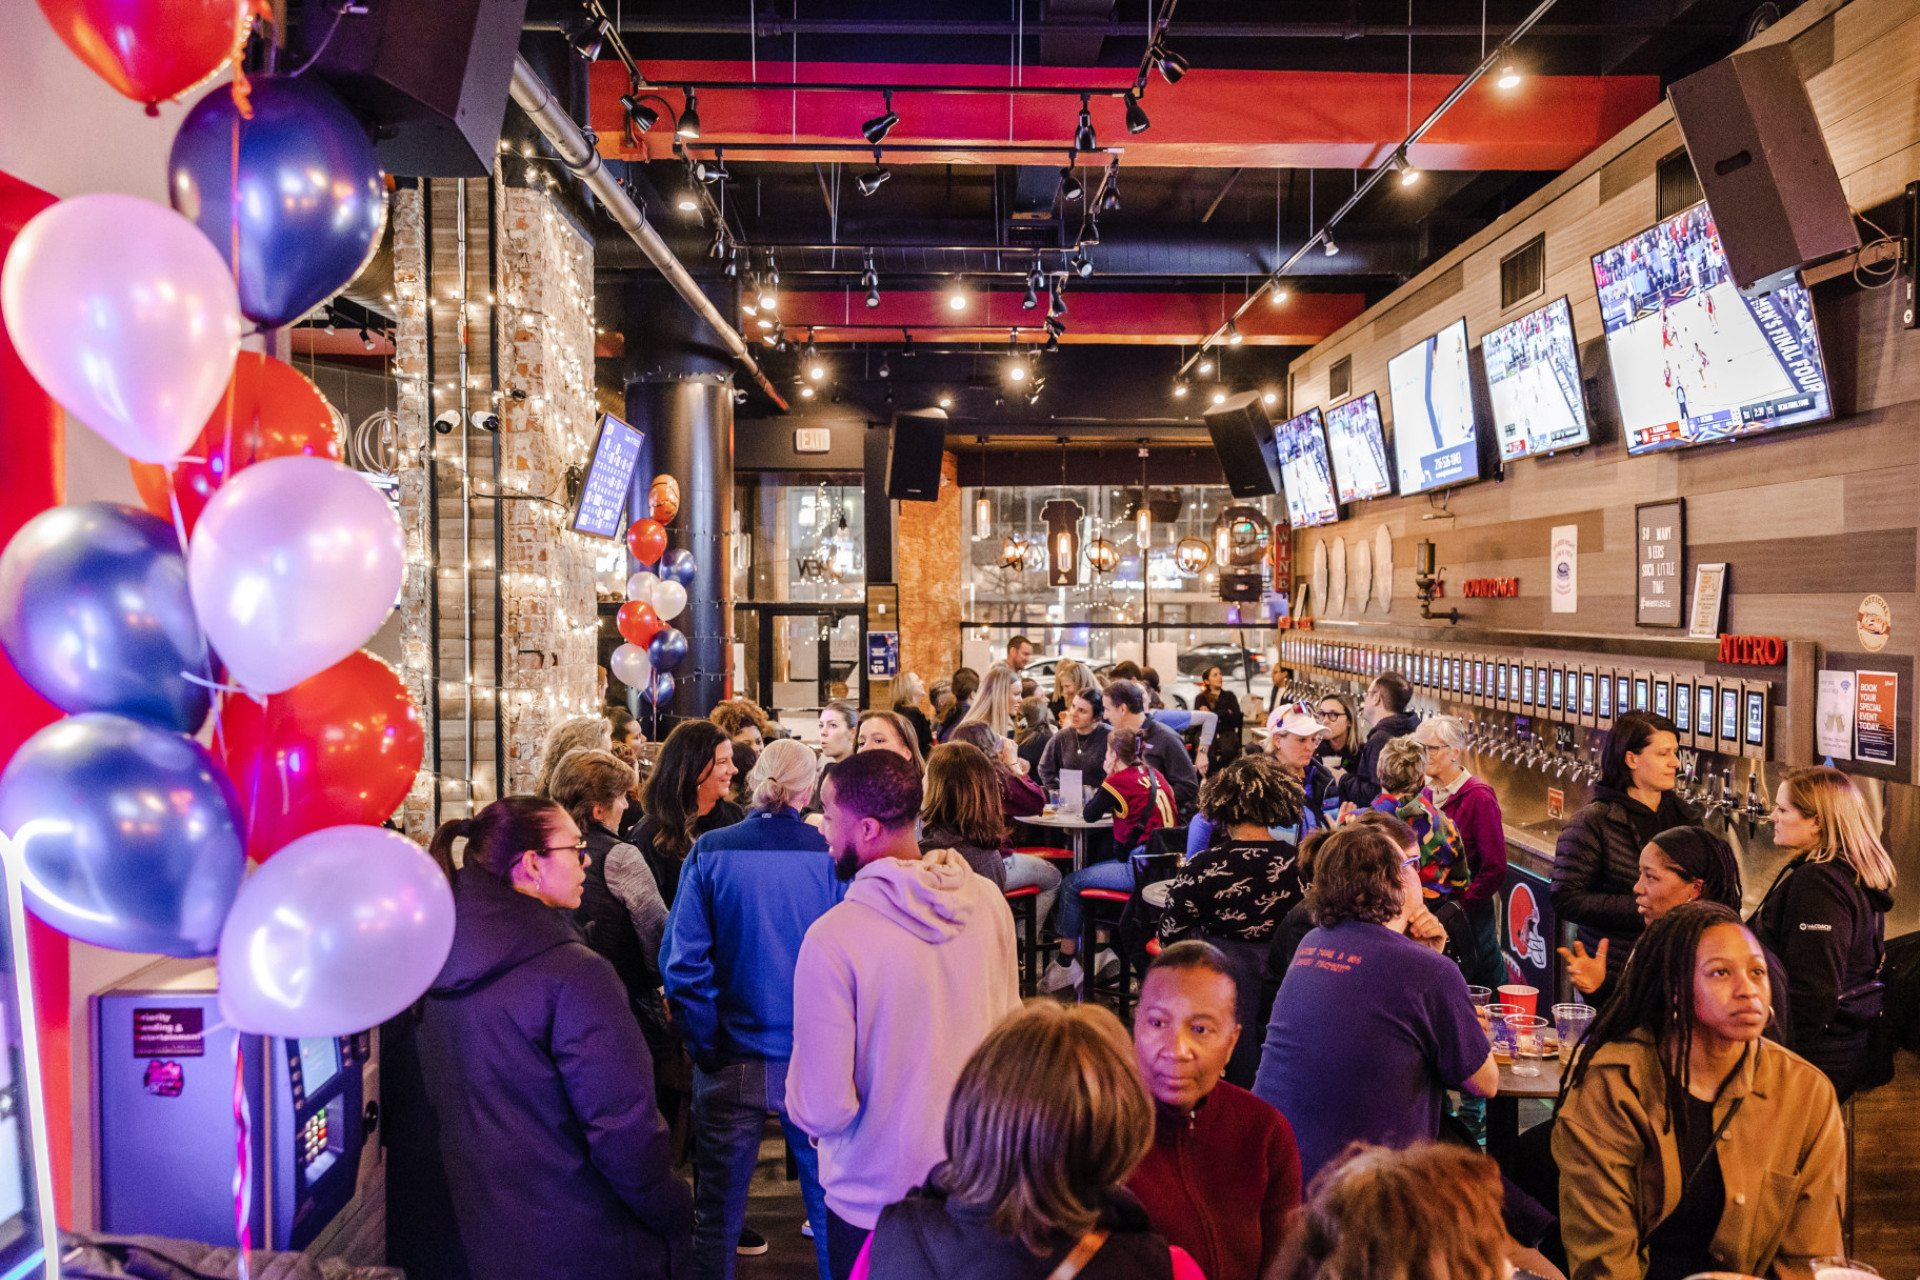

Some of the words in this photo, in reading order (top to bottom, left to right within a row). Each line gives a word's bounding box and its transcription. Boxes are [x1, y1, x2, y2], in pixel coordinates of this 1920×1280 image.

[1768, 327, 1802, 362] FINAL
[1788, 358, 1825, 392] FOUR
[800, 431, 826, 449] EXIT
[1277, 530, 1291, 589] WINE
[1657, 562, 1675, 576] LITTLE
[1718, 633, 1784, 665] NITRO
[1860, 683, 1877, 692] BOOK
[1860, 693, 1877, 702] YOUR
[1859, 702, 1882, 712] SPECIAL
[1859, 712, 1878, 722] EVENT
